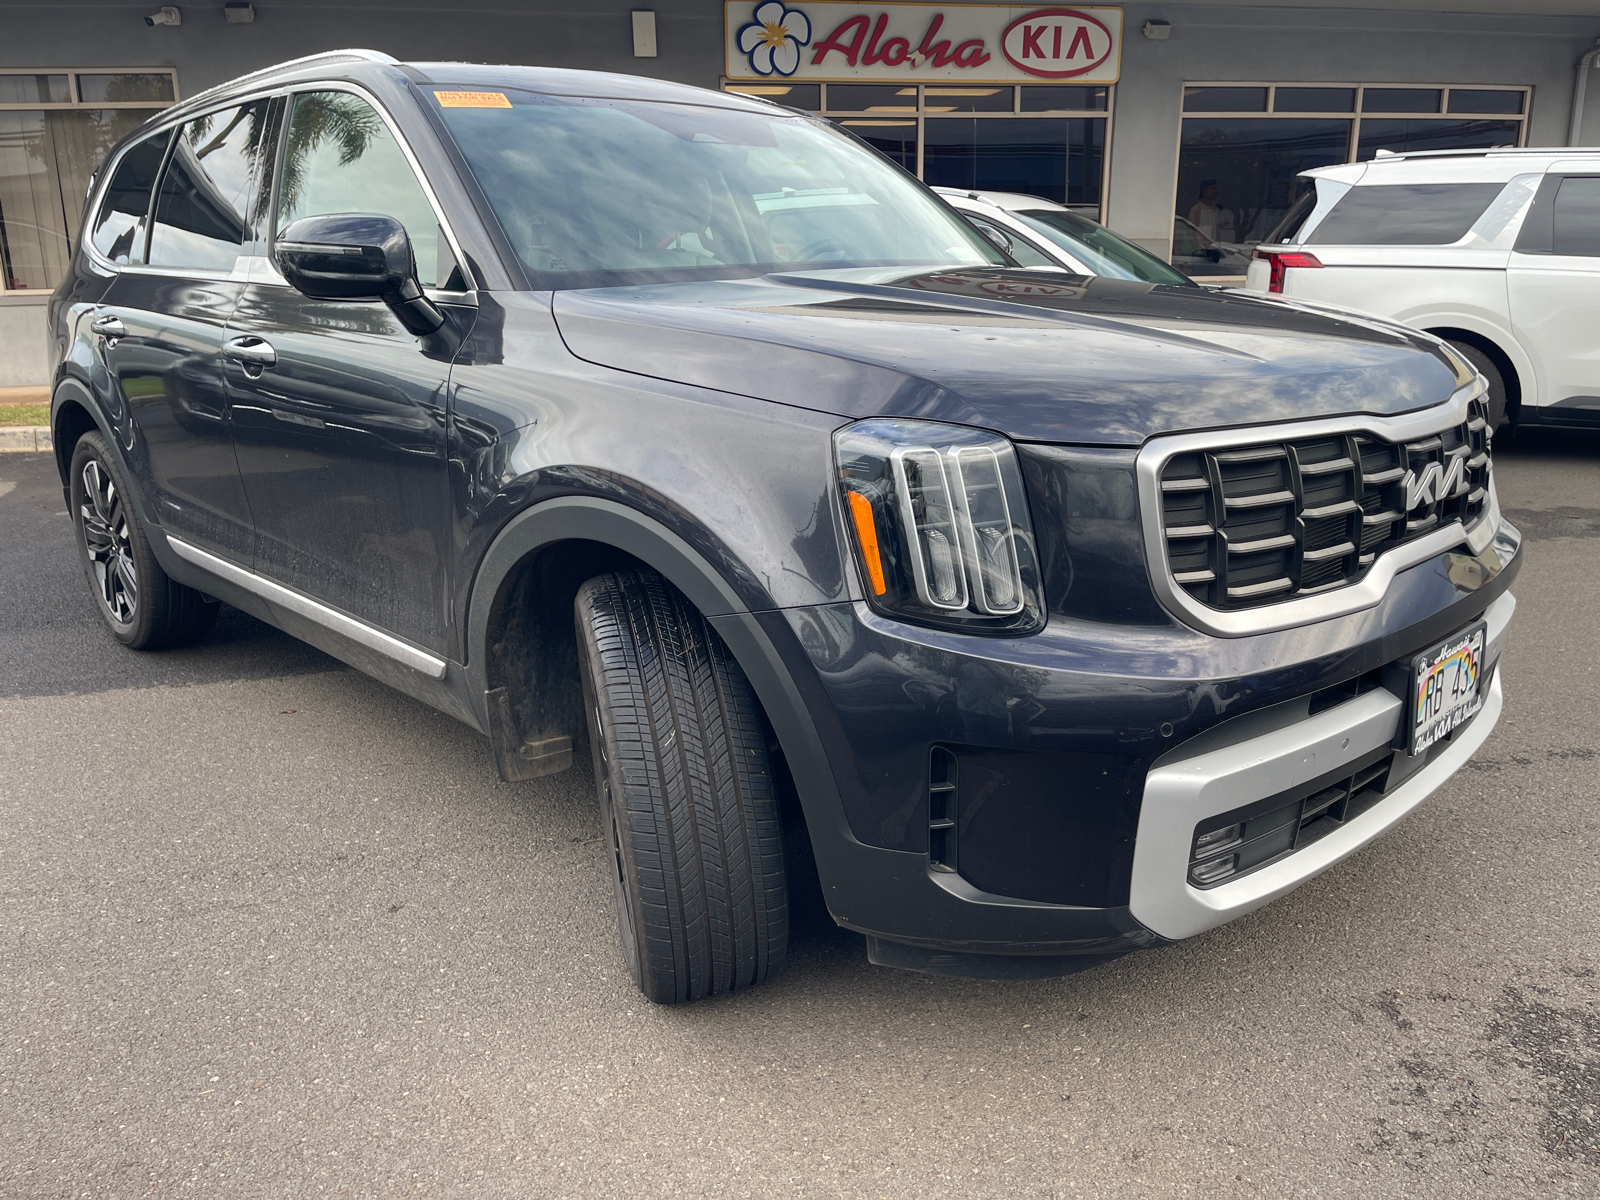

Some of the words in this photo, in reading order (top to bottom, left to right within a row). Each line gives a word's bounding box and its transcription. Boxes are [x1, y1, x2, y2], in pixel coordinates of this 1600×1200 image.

[811, 13, 991, 68] Aloha
[1021, 25, 1095, 60] KIA
[1434, 634, 1471, 664] Hawaii
[1452, 645, 1480, 700] 435
